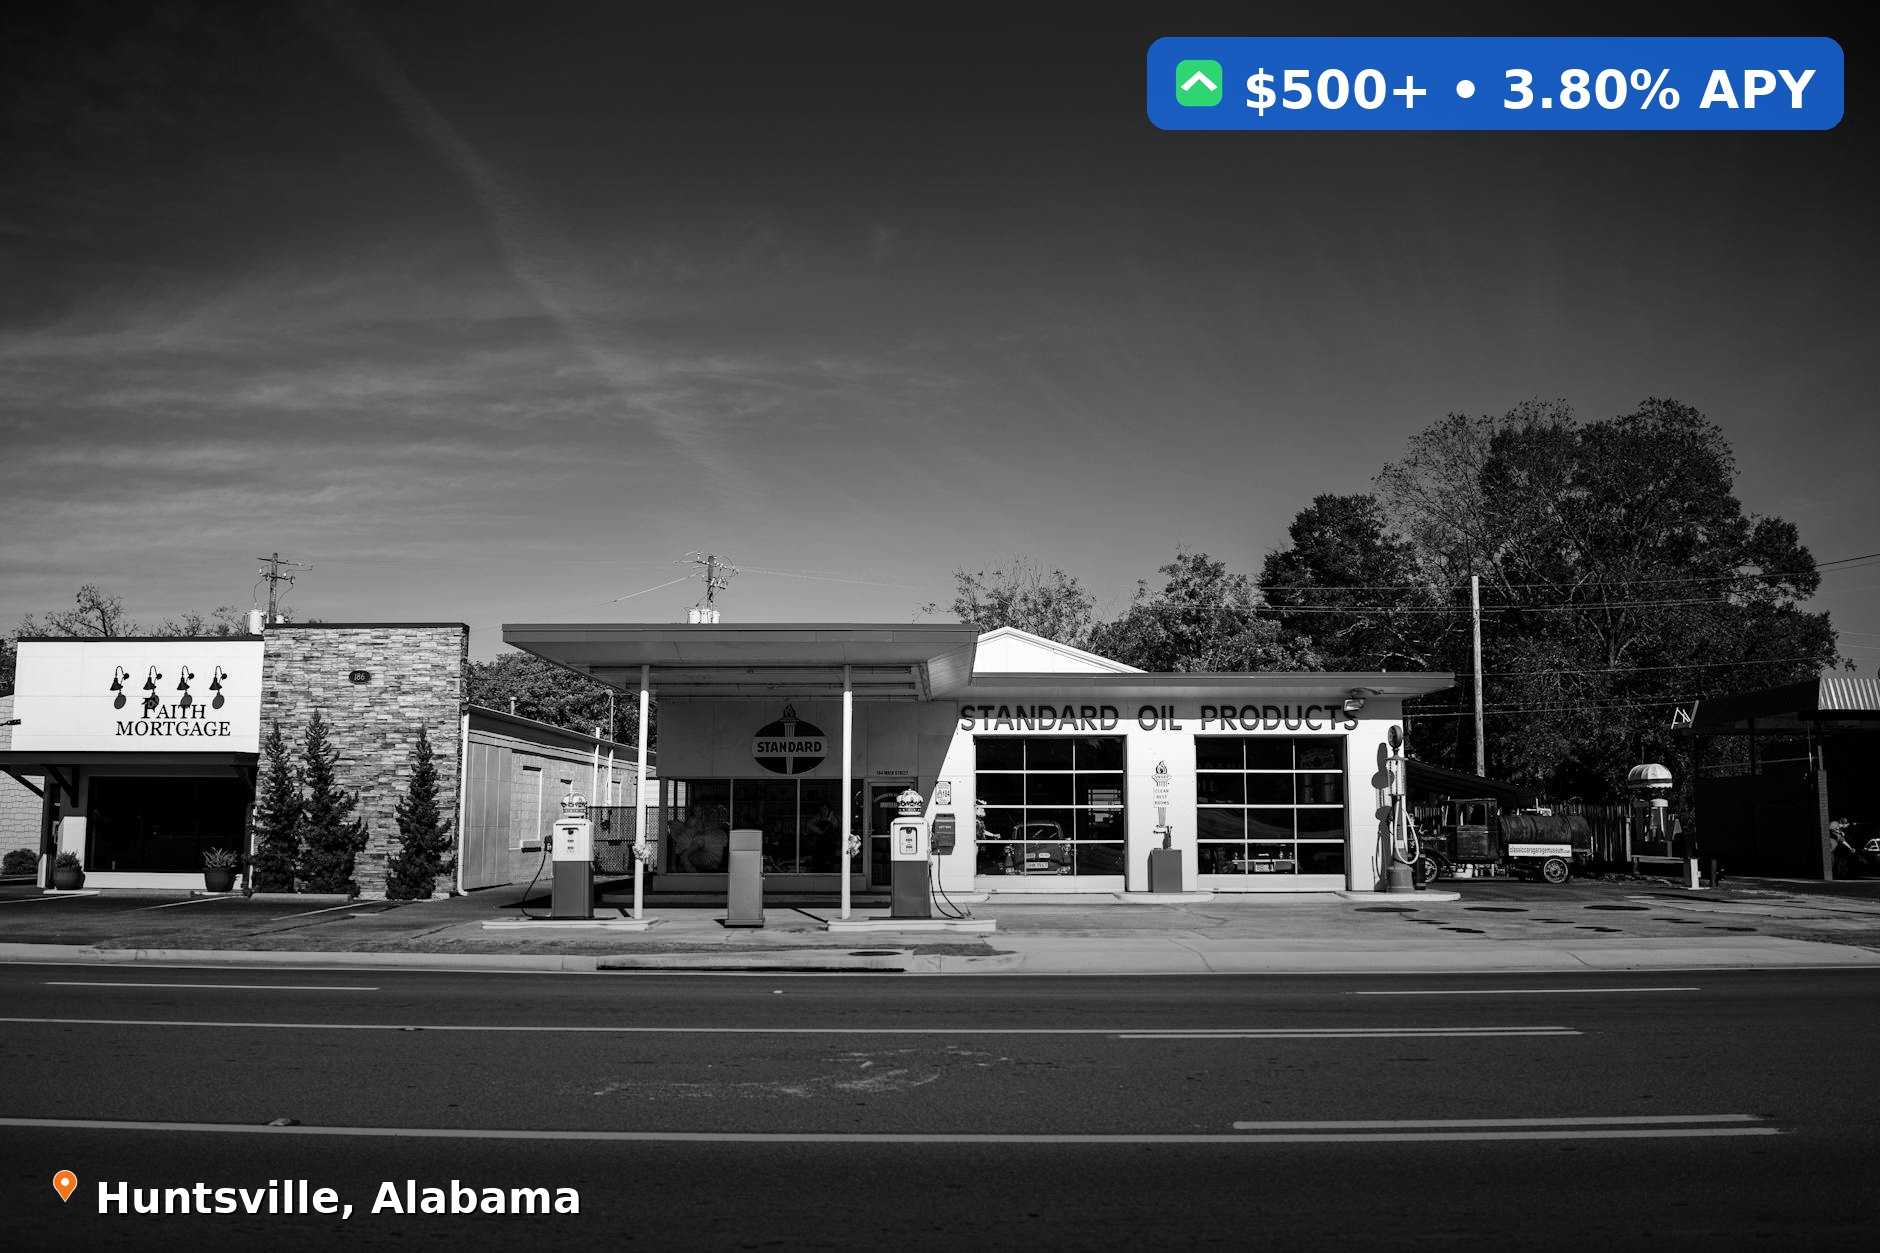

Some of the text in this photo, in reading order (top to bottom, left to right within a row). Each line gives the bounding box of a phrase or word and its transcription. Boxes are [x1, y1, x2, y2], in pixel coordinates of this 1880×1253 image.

[140, 698, 206, 719] FAITH
[961, 704, 1359, 731] STANDARD OIL PRODUCTS
[115, 721, 231, 737] MORTGAGE
[757, 741, 823, 753] STANDARD
